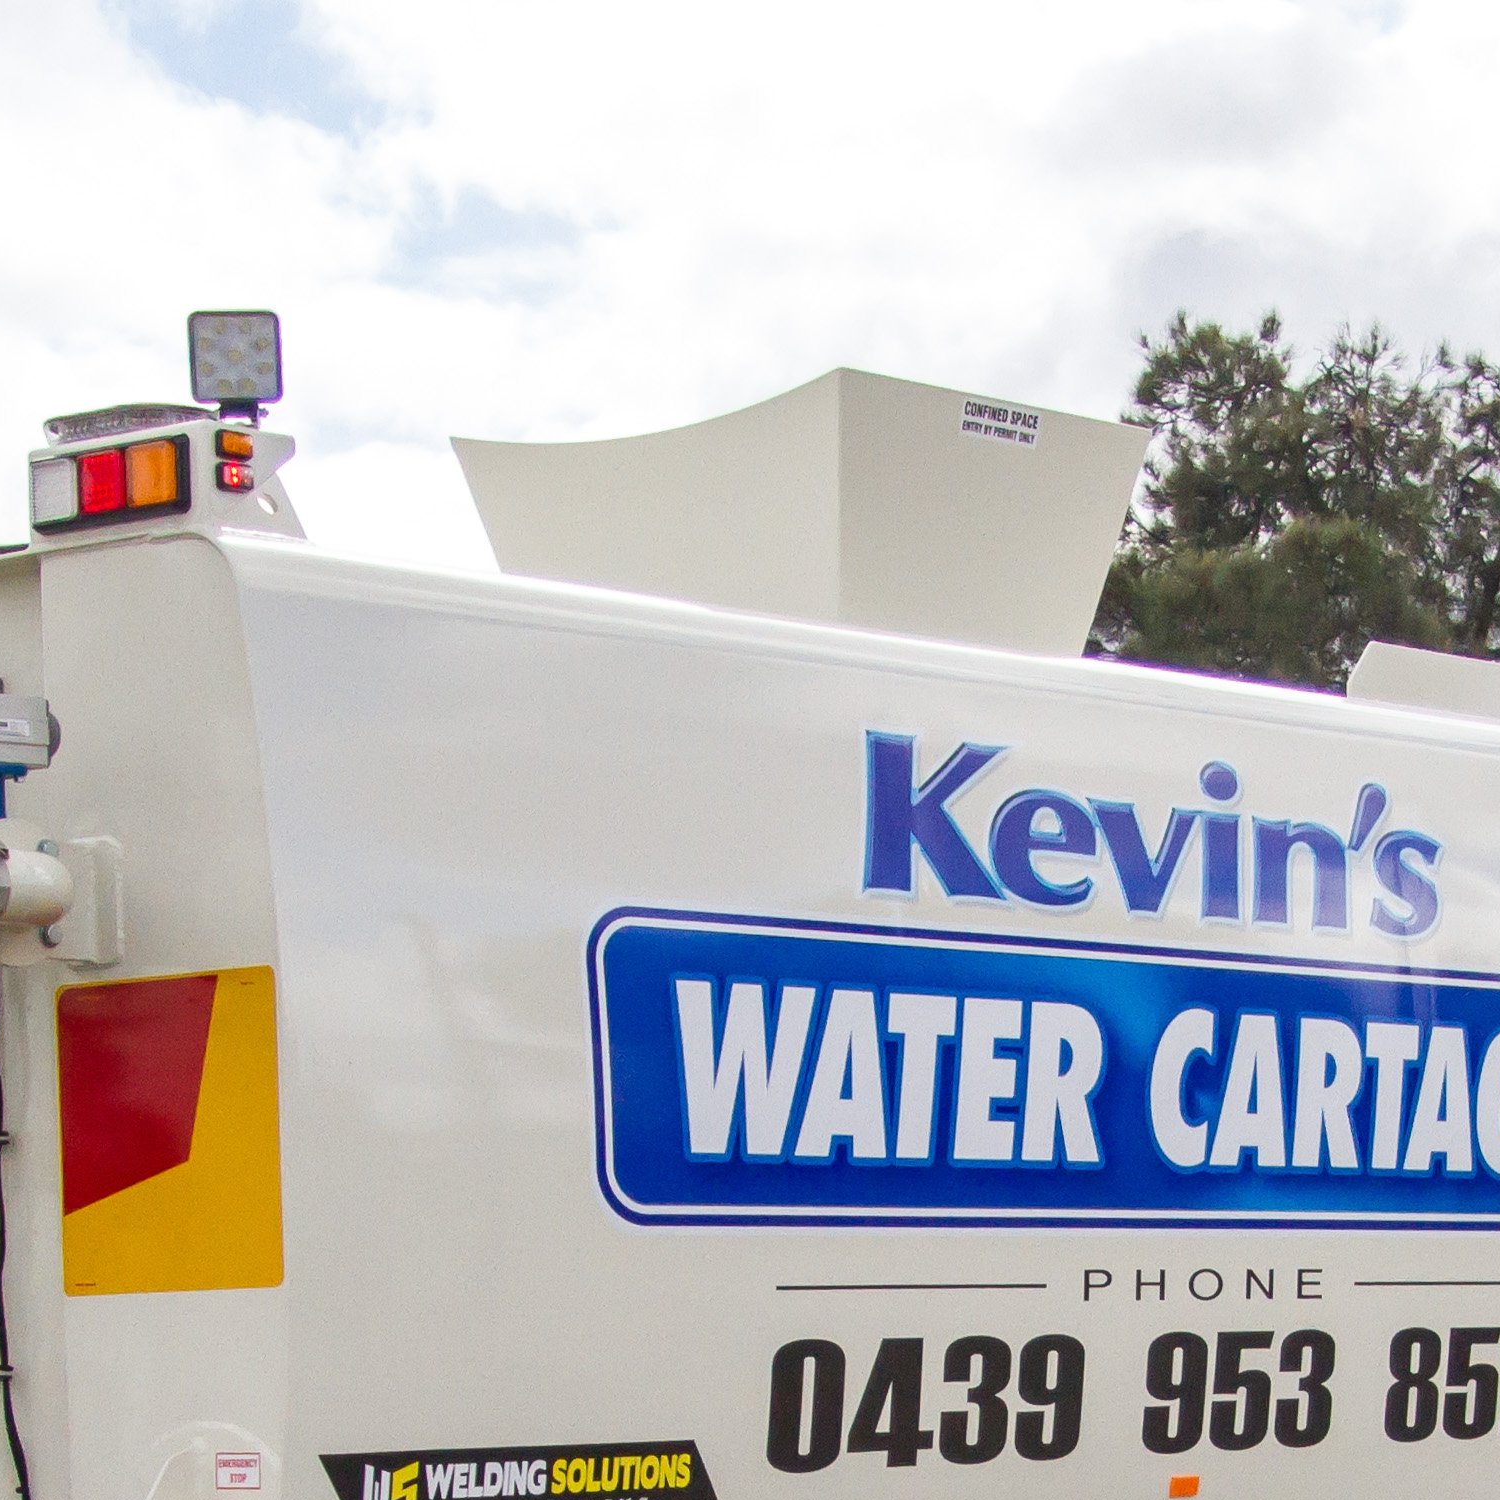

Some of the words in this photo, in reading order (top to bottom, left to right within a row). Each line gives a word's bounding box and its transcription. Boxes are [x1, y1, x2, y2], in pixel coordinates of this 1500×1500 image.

[962, 420, 982, 433] ENTRY
[993, 426, 1018, 442] PERMIT
[964, 401, 1008, 423] CONFINED
[1010, 410, 1039, 429] SPACE
[862, 729, 1442, 940] Kevin's
[674, 978, 1102, 1164] WATER
[1081, 1268, 1324, 1303] PHONE
[765, 1333, 1086, 1474] 0439
[1141, 1329, 1337, 1455] 953
[218, 1459, 257, 1468] EMERGENCY
[230, 1473, 247, 1484] STOP
[425, 1459, 548, 1500] WELDING
[551, 1453, 692, 1495] SOLUTIONS
